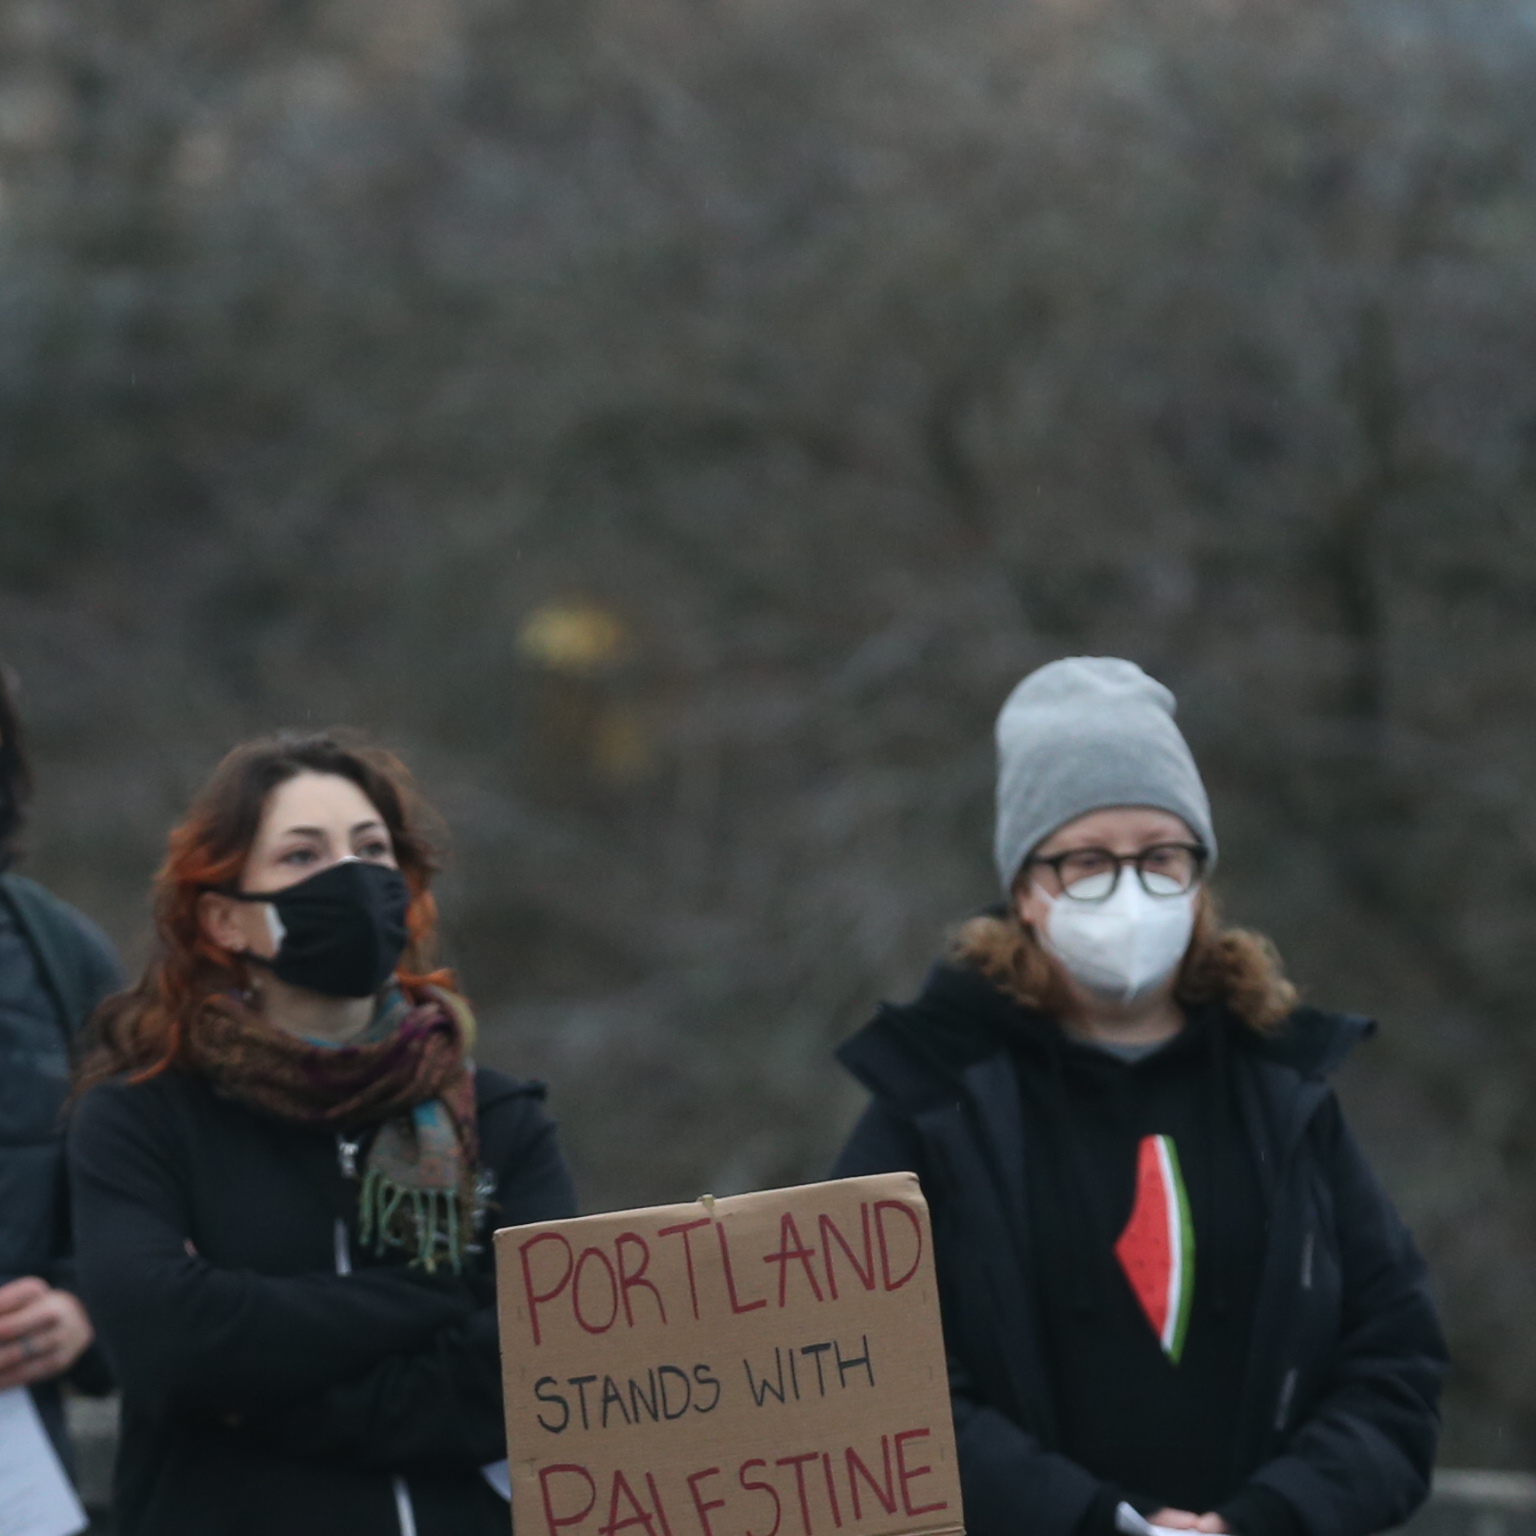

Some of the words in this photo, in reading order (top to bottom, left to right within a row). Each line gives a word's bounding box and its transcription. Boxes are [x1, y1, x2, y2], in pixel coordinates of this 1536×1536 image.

[519, 1200, 922, 1346] PORTLAND
[534, 1364, 720, 1433] STANDS
[744, 1335, 875, 1407] WITH
